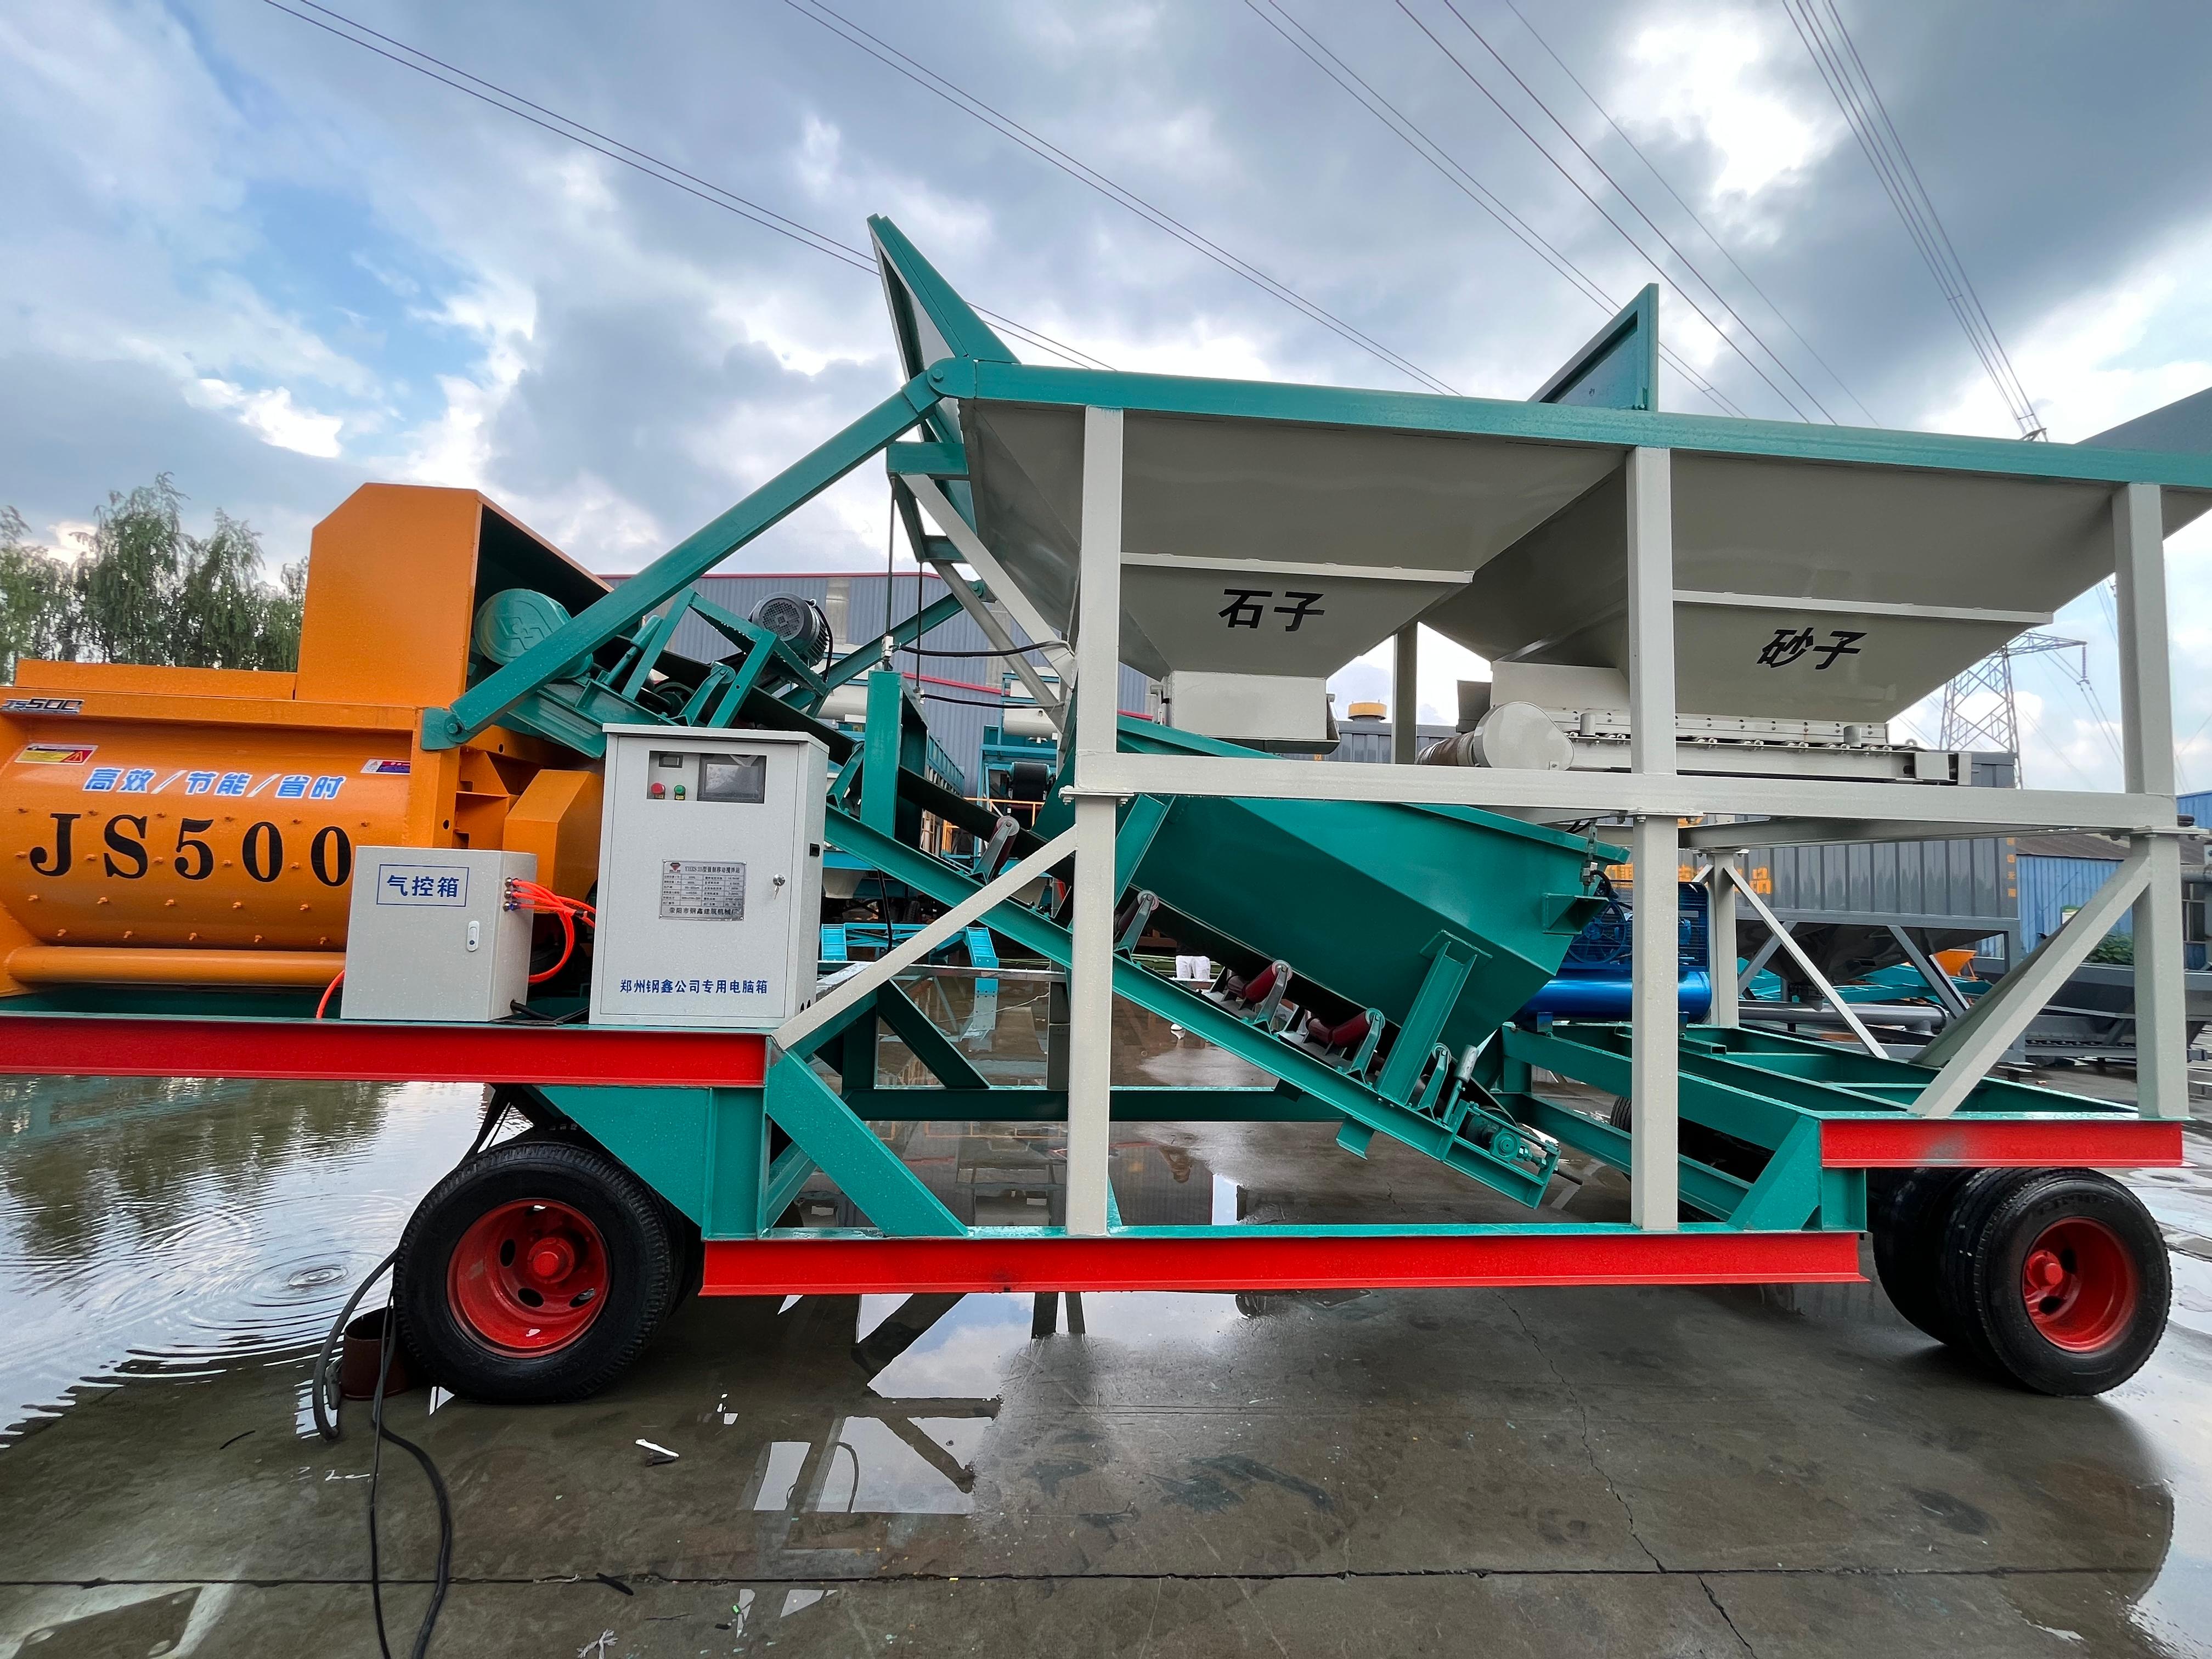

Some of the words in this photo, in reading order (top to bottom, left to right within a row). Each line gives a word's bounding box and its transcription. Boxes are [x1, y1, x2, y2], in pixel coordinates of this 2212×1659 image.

[1218, 589, 1325, 631] 石子
[1757, 627, 1867, 670] 砂子
[30, 813, 351, 887] JS500
[387, 874, 460, 898] 气控箱
